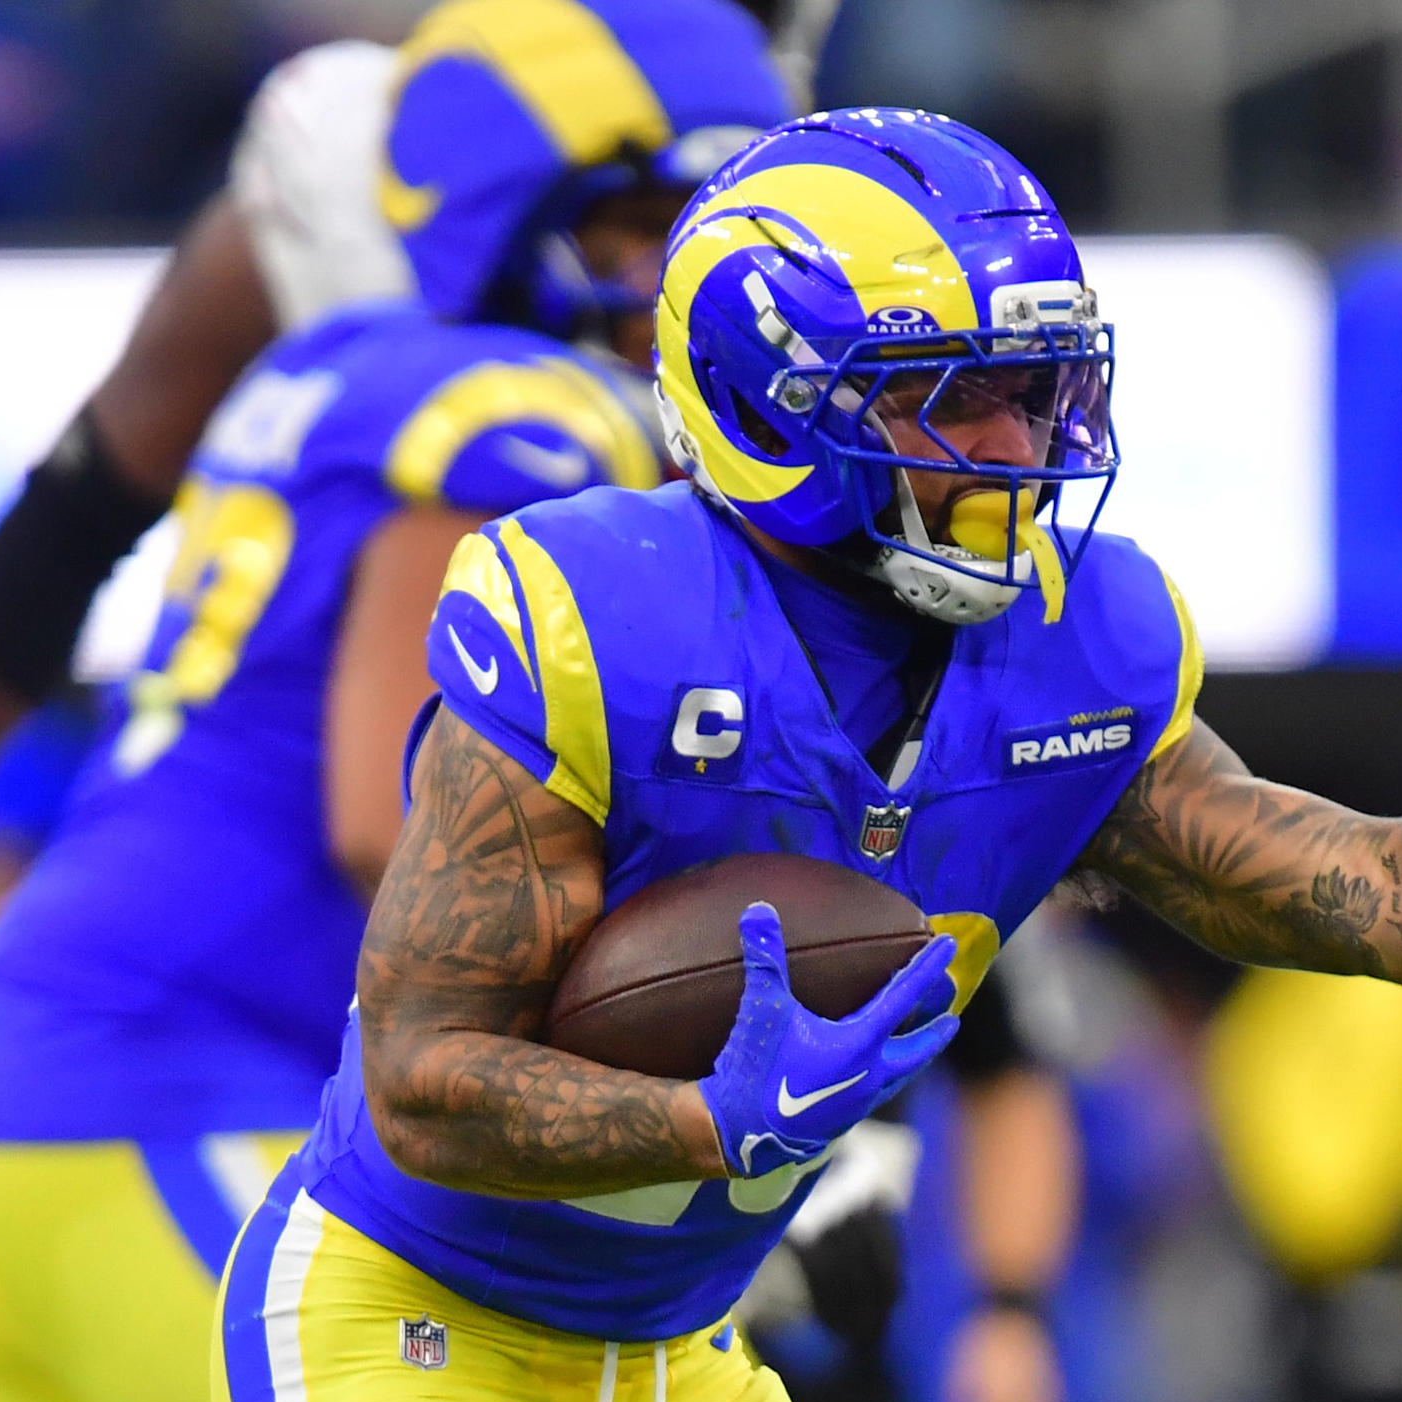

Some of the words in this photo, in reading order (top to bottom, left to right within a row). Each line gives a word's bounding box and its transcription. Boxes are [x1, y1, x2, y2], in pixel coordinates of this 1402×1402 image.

[867, 324, 933, 333] OAKLEY
[672, 688, 744, 759] C
[1012, 724, 1131, 765] RAMS
[409, 1339, 441, 1362] NFL
